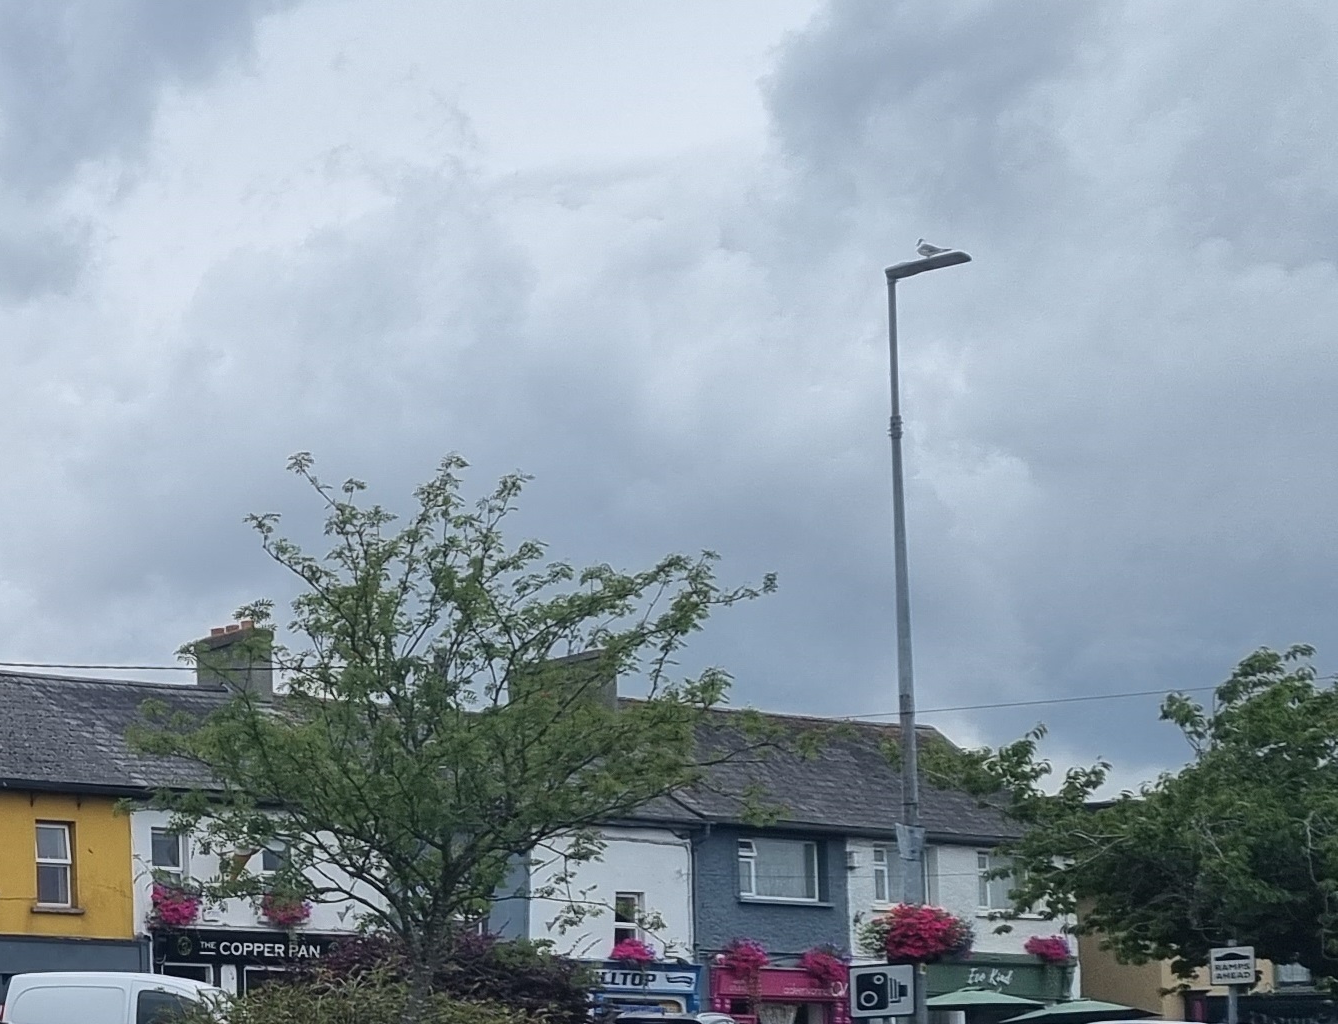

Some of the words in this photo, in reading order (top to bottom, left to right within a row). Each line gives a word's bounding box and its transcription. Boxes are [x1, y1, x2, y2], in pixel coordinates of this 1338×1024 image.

[199, 941, 217, 949] THE
[219, 941, 285, 957] COPPER
[288, 945, 321, 958] PAN
[1214, 962, 1251, 972] RAMPS
[1215, 972, 1251, 980] AHEAD
